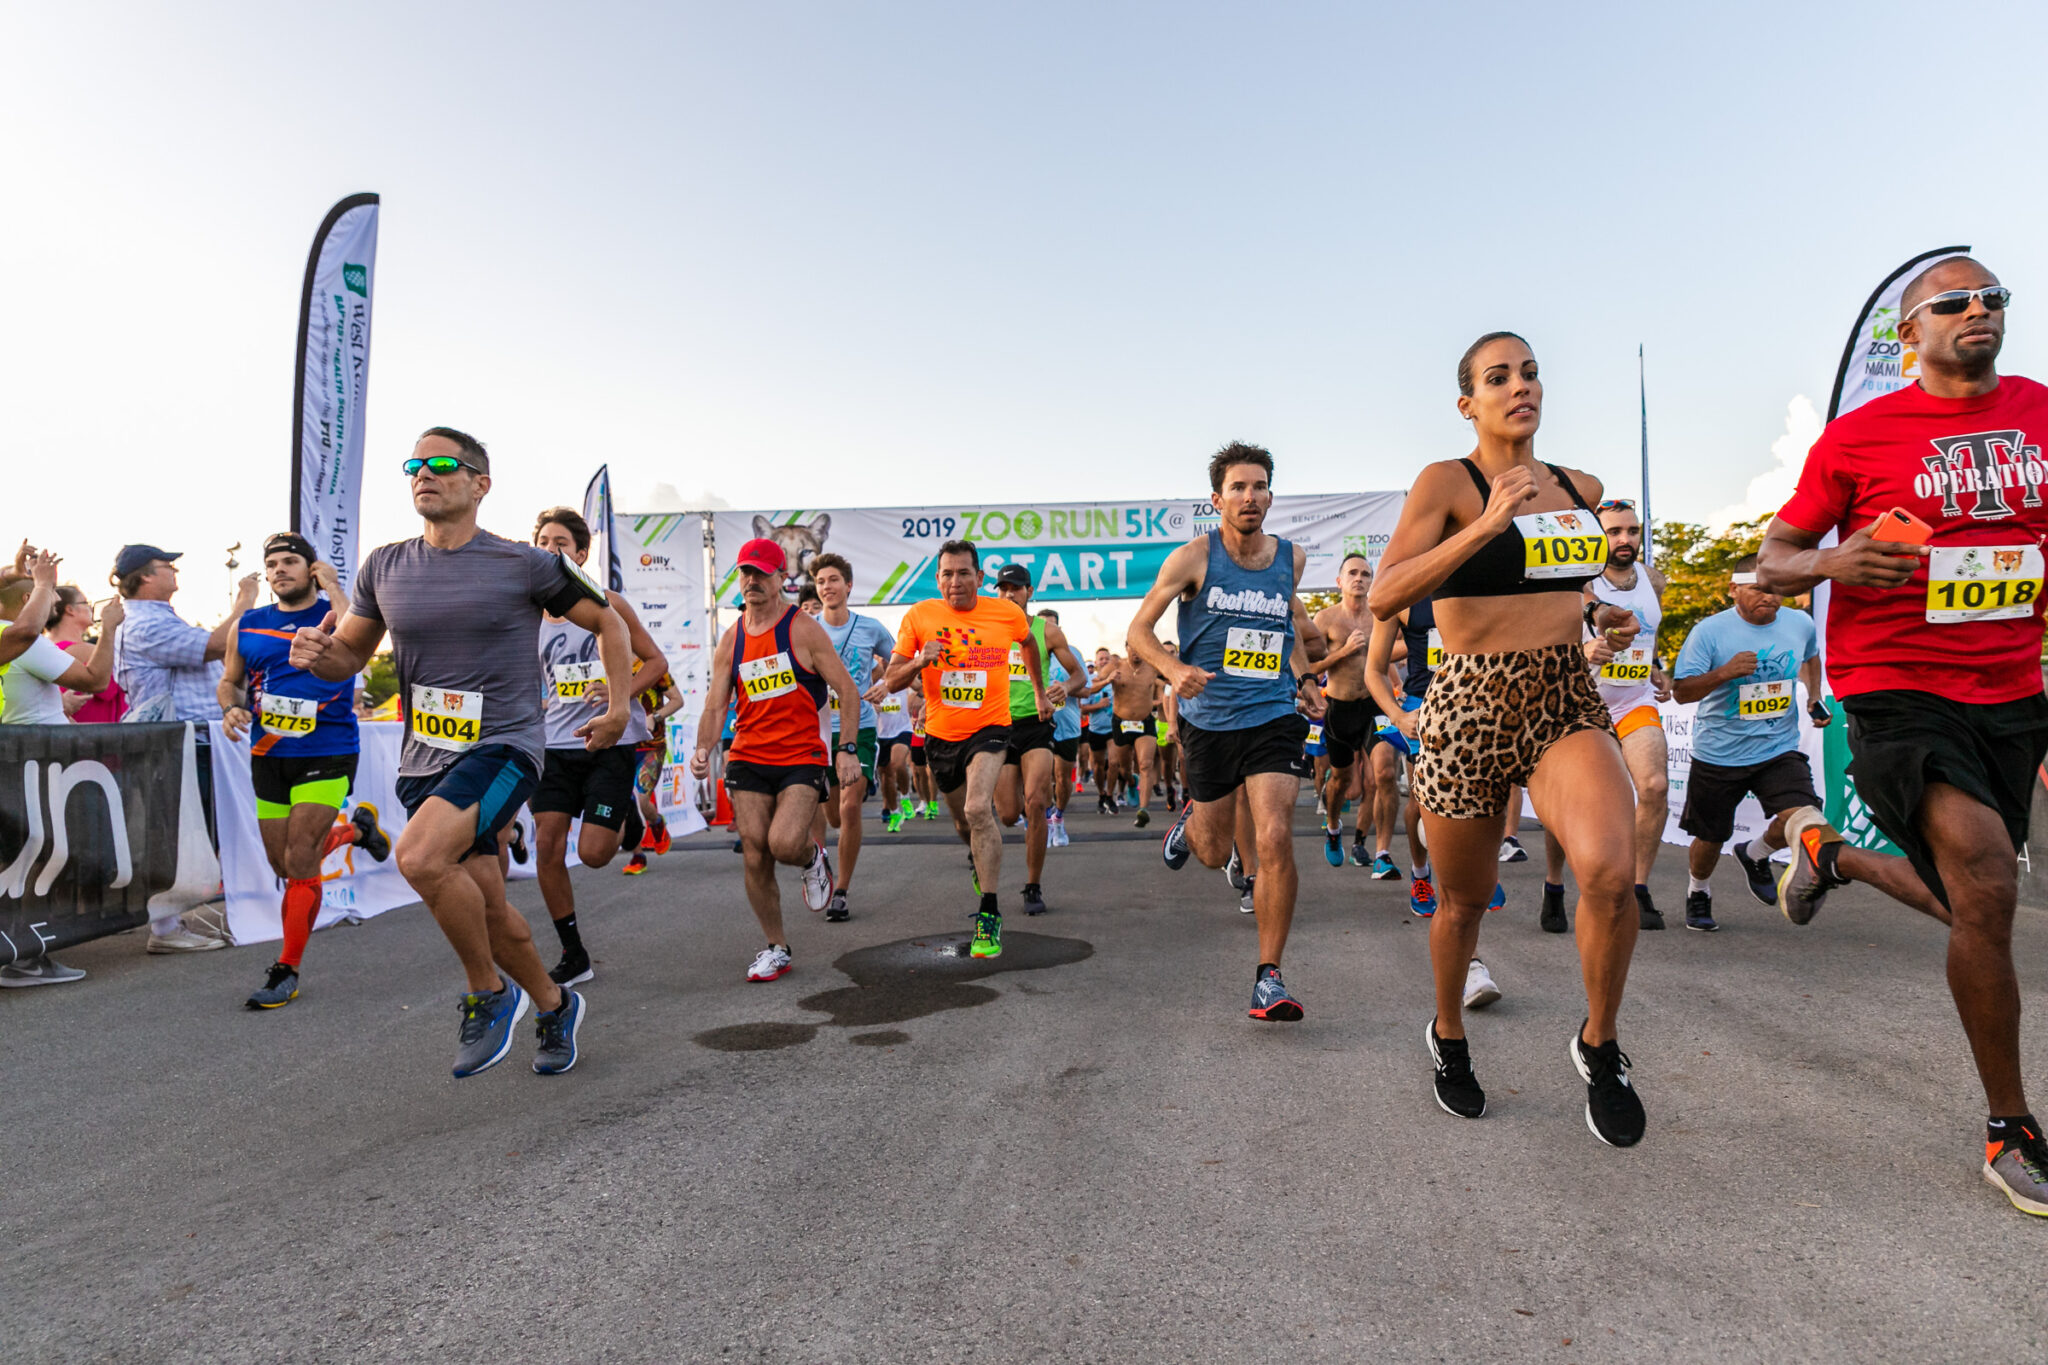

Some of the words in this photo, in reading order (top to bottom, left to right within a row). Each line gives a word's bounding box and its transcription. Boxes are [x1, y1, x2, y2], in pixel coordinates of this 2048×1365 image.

[334, 294, 346, 346] BAPTIST
[351, 303, 365, 349] West
[1868, 342, 1900, 356] ZOO
[333, 347, 345, 395] HEALTH
[1865, 361, 1900, 377] MIAMI
[1862, 378, 1906, 391] FOUND
[336, 397, 345, 439] SOUTH
[320, 419, 332, 449] FIU
[329, 442, 343, 495] FLORIDA
[902, 517, 956, 538] 2019
[960, 510, 1043, 542] ZOO
[1050, 508, 1119, 539] RUN
[1125, 507, 1169, 539] 5K
[1169, 512, 1185, 529] @
[1367, 534, 1390, 544] ZOO
[1533, 537, 1603, 564] 1037
[1206, 586, 1289, 618] FootWorks
[1937, 581, 2036, 608] 1018
[1227, 650, 1278, 670] 2783
[1606, 664, 1649, 679] 1062
[748, 671, 792, 693] 1076
[942, 687, 984, 701] 1078
[1743, 696, 1790, 714] 1092
[264, 712, 312, 732] 2775
[416, 712, 475, 741] 1004
[1665, 714, 1689, 736] West
